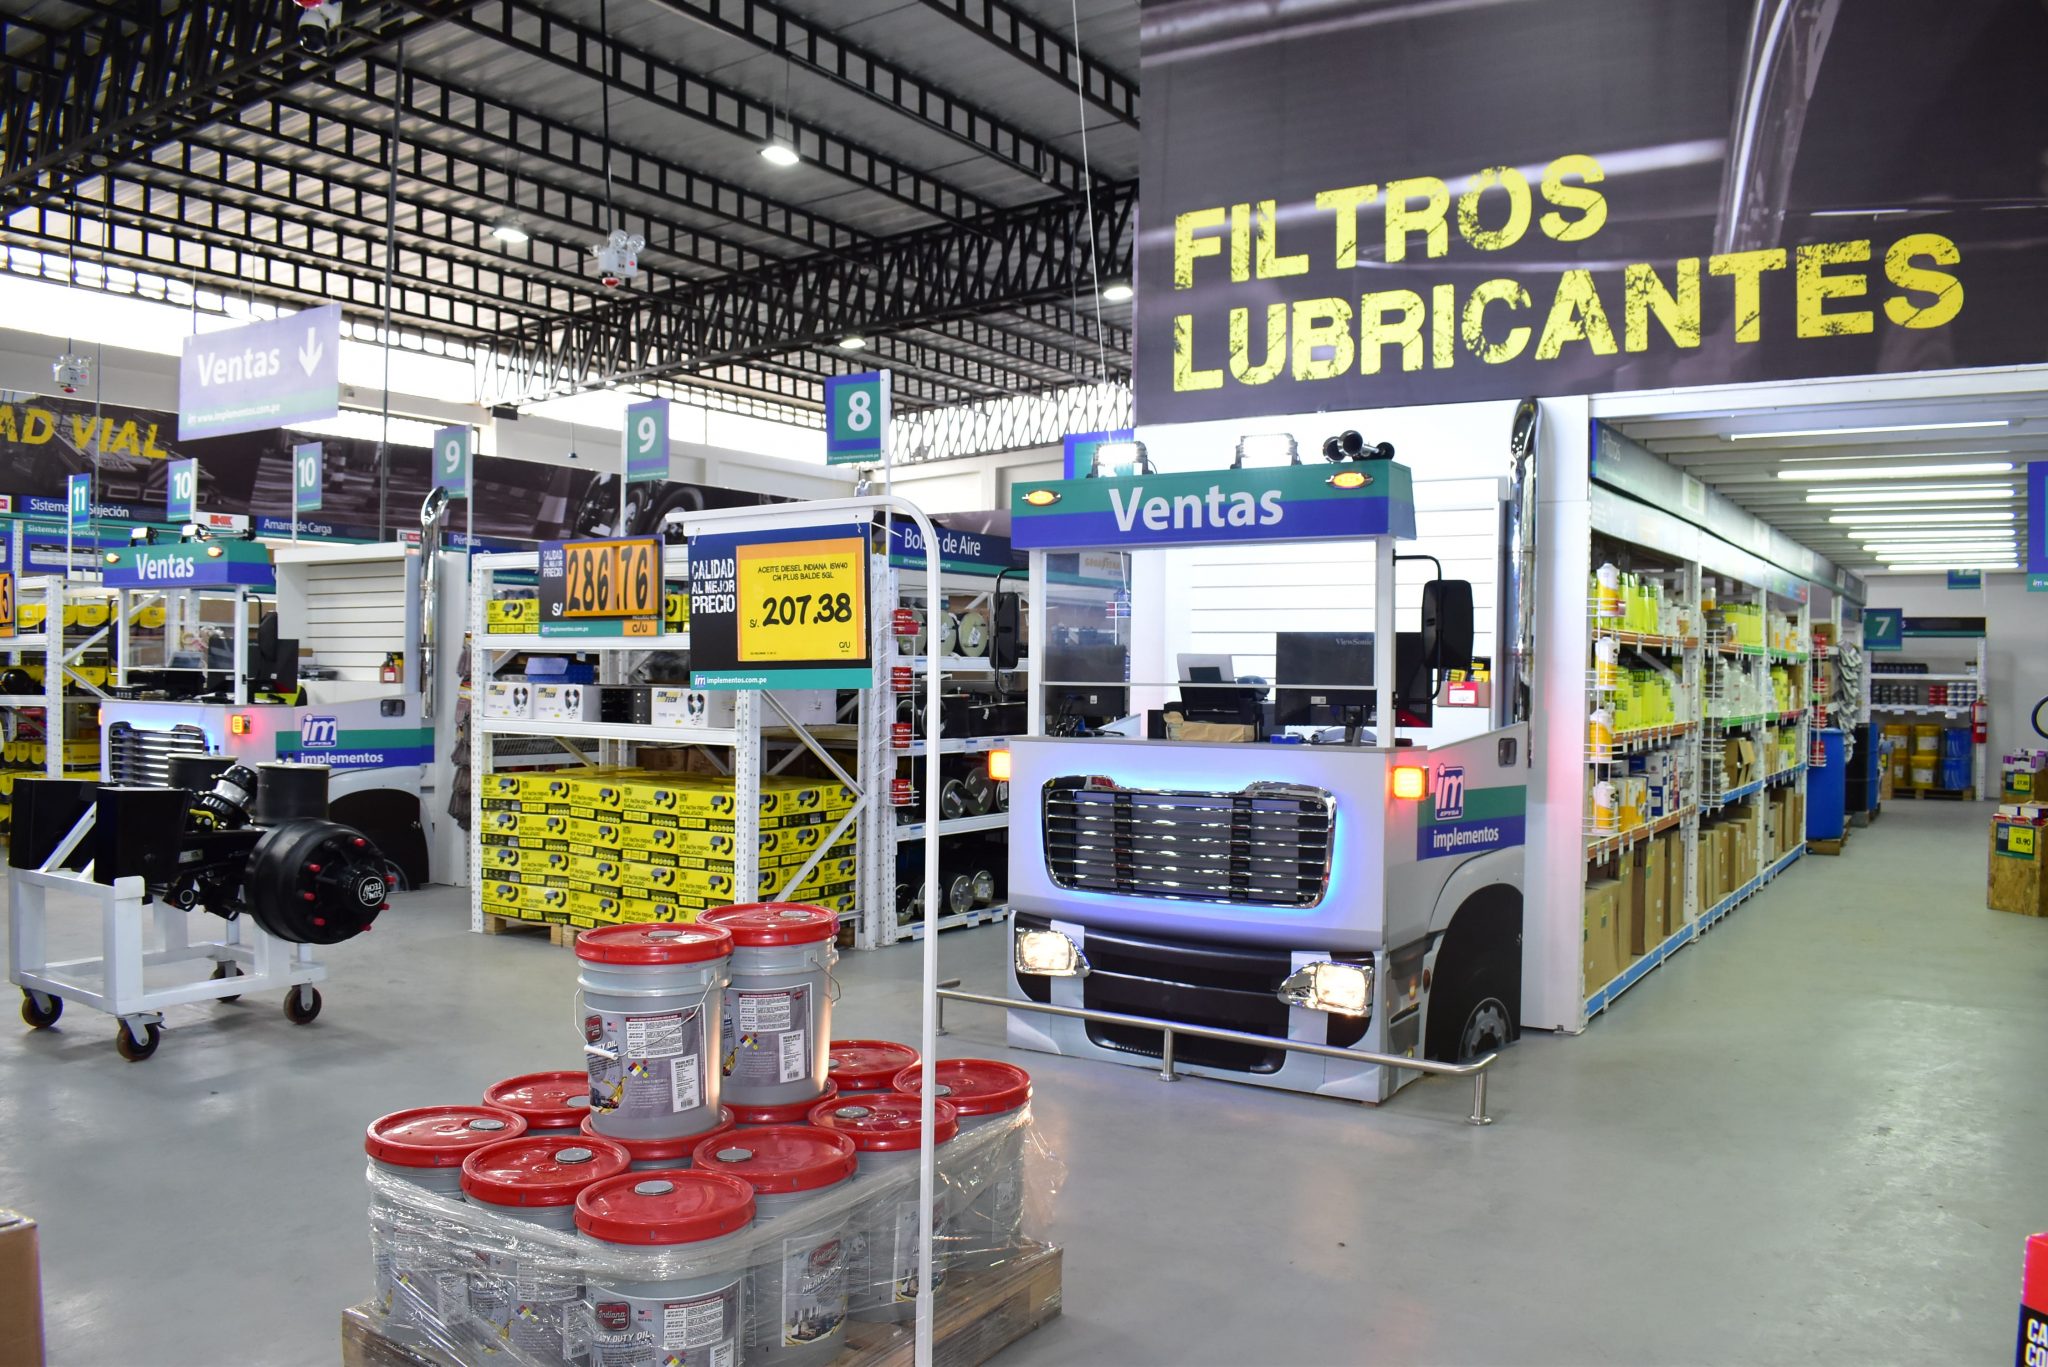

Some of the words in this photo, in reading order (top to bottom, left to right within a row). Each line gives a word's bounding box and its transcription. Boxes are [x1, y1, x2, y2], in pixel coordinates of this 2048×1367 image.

[1174, 153, 1608, 290] FILTROS
[1173, 233, 1966, 392] LUBRICANTES
[197, 347, 280, 386] Ventas
[847, 391, 872, 432] 8
[72, 413, 168, 460] VIAL
[638, 416, 656, 453] 9
[445, 440, 460, 474] 9
[298, 457, 316, 488] 10
[174, 471, 192, 500] 10
[30, 498, 68, 513] Sistema
[74, 486, 86, 511] 11
[1108, 484, 1284, 532] Ventas
[297, 520, 307, 532] de
[308, 521, 332, 537] Carga
[942, 532, 957, 554] de
[959, 535, 981, 557] Aire
[135, 553, 194, 581] Ventas
[691, 557, 735, 580] CALIDAD
[757, 565, 779, 574] ACEITE
[781, 564, 801, 573] DIESEL
[803, 563, 827, 571] INDIANA
[783, 573, 799, 581] PLUS
[800, 572, 820, 580] BALDE
[691, 581, 703, 594] AL
[705, 579, 735, 594] MEJOR
[691, 594, 736, 614] PRECIO
[762, 592, 853, 627] 207.38
[1875, 616, 1891, 637] 7
[1335, 638, 1373, 646] ViewSonic
[706, 677, 768, 685] implementos.com.pe
[300, 752, 384, 765] implementos
[1433, 826, 1499, 852] implementos
[597, 1309, 626, 1319] Indiana
[612, 1332, 635, 1343] DUTY
[637, 1330, 650, 1341] OIL
